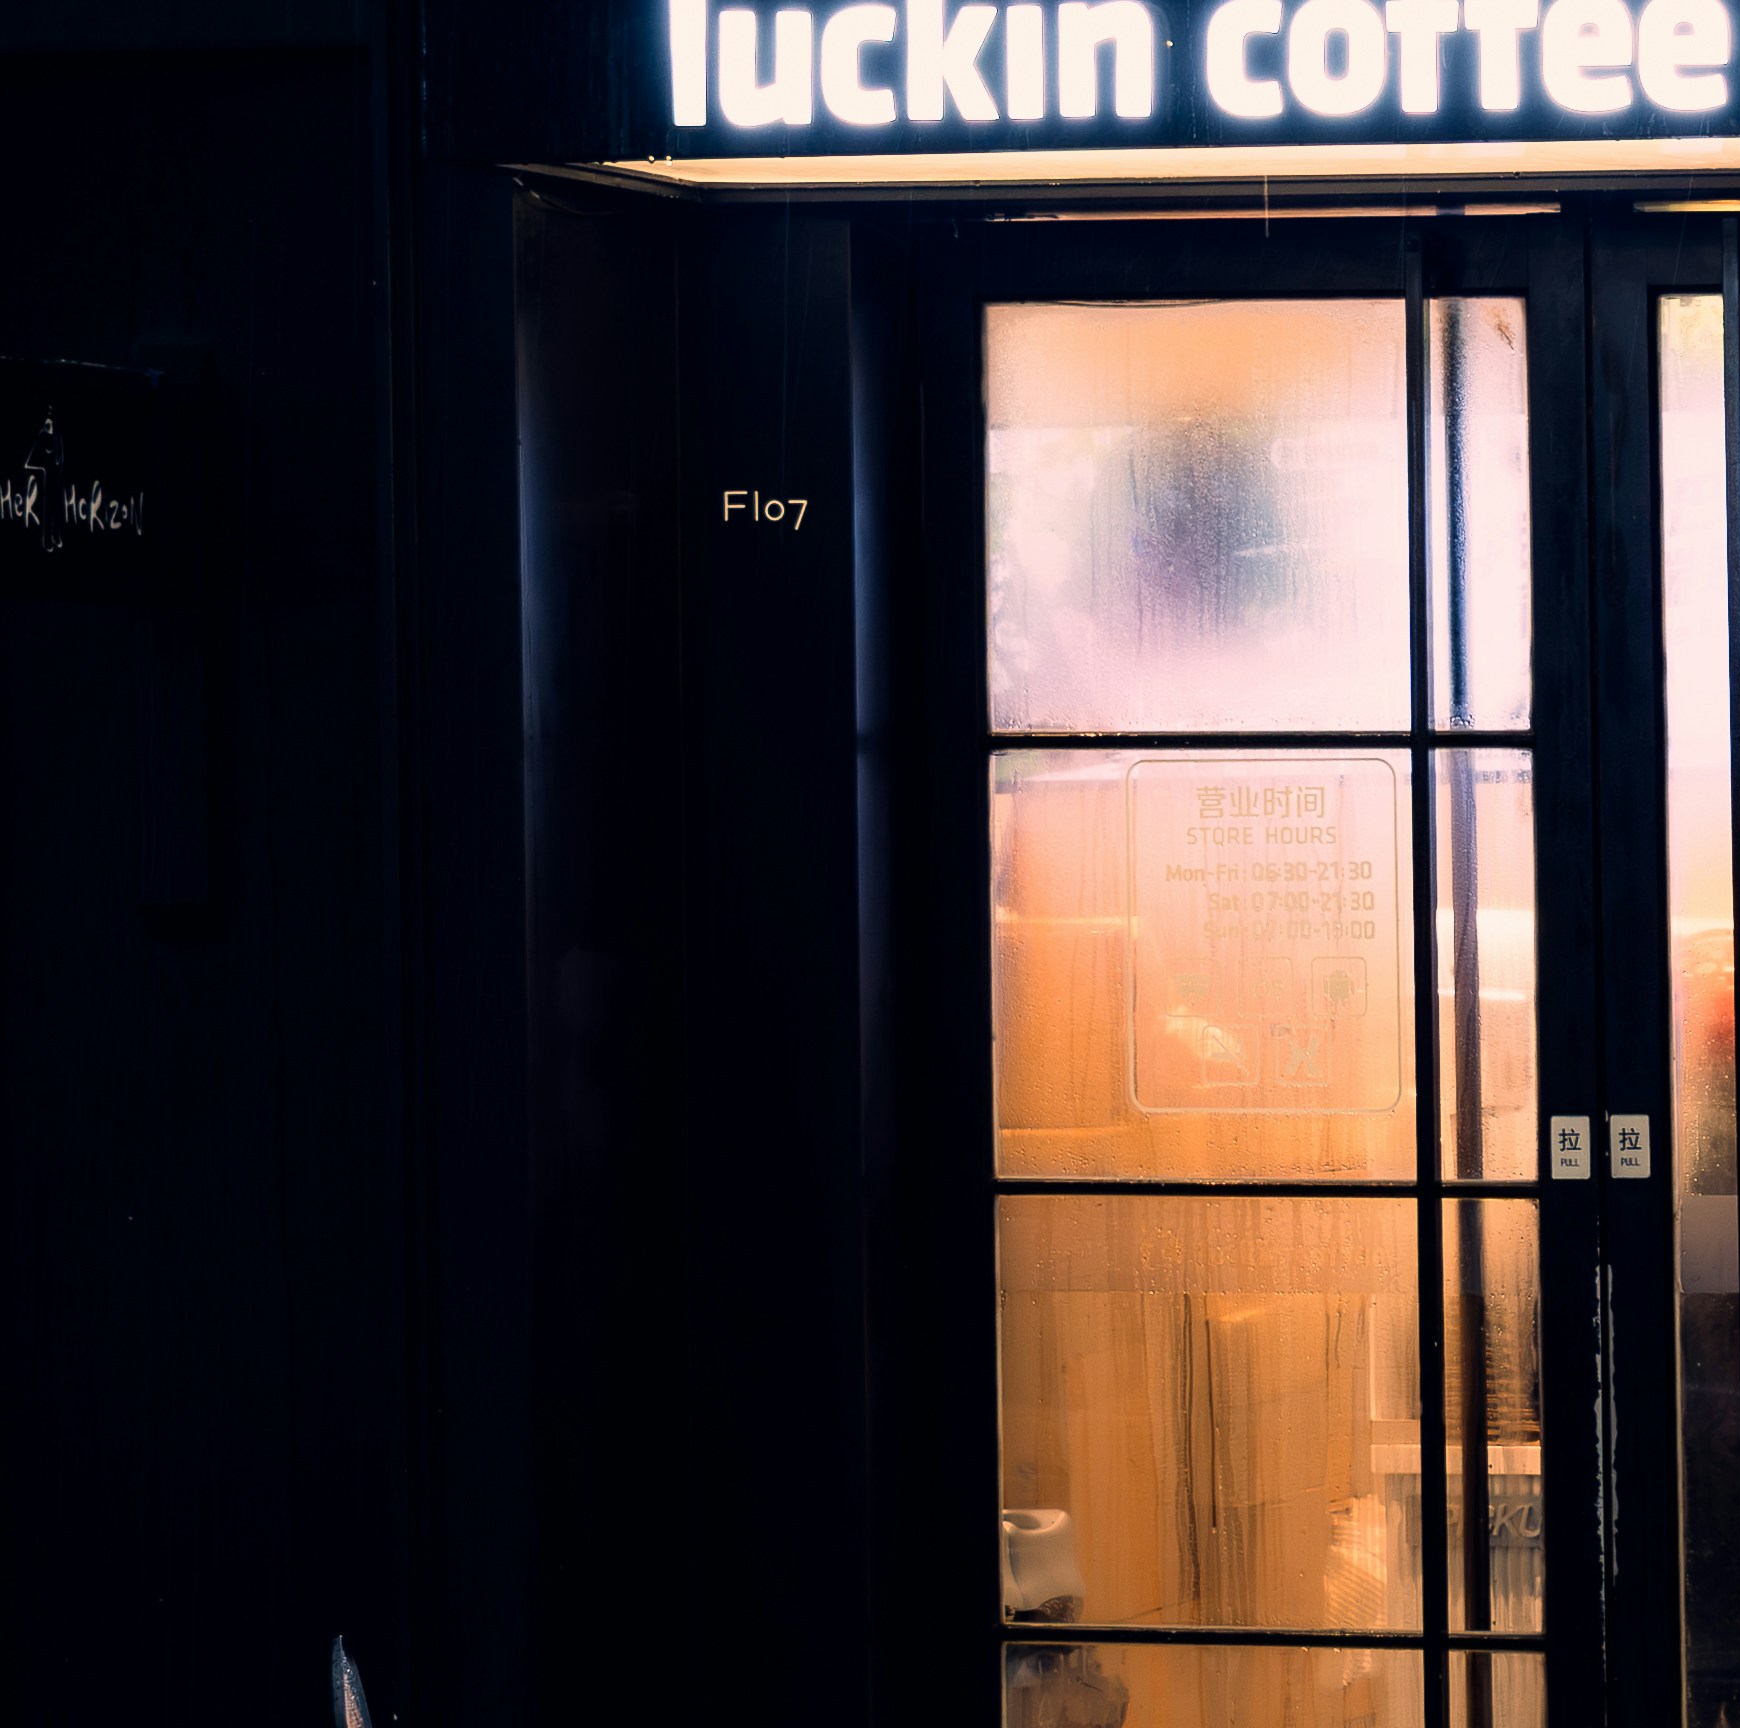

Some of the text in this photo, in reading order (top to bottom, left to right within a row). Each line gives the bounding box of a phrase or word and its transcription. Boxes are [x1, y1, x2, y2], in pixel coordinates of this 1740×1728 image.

[1196, 785, 1326, 819] 营业时间
[1186, 826, 1337, 846] STORE HOURS
[1558, 1128, 1582, 1151] 拉
[1618, 1127, 1642, 1151] 拉
[1561, 1159, 1579, 1167] PULL
[1620, 1158, 1640, 1166] PULL
